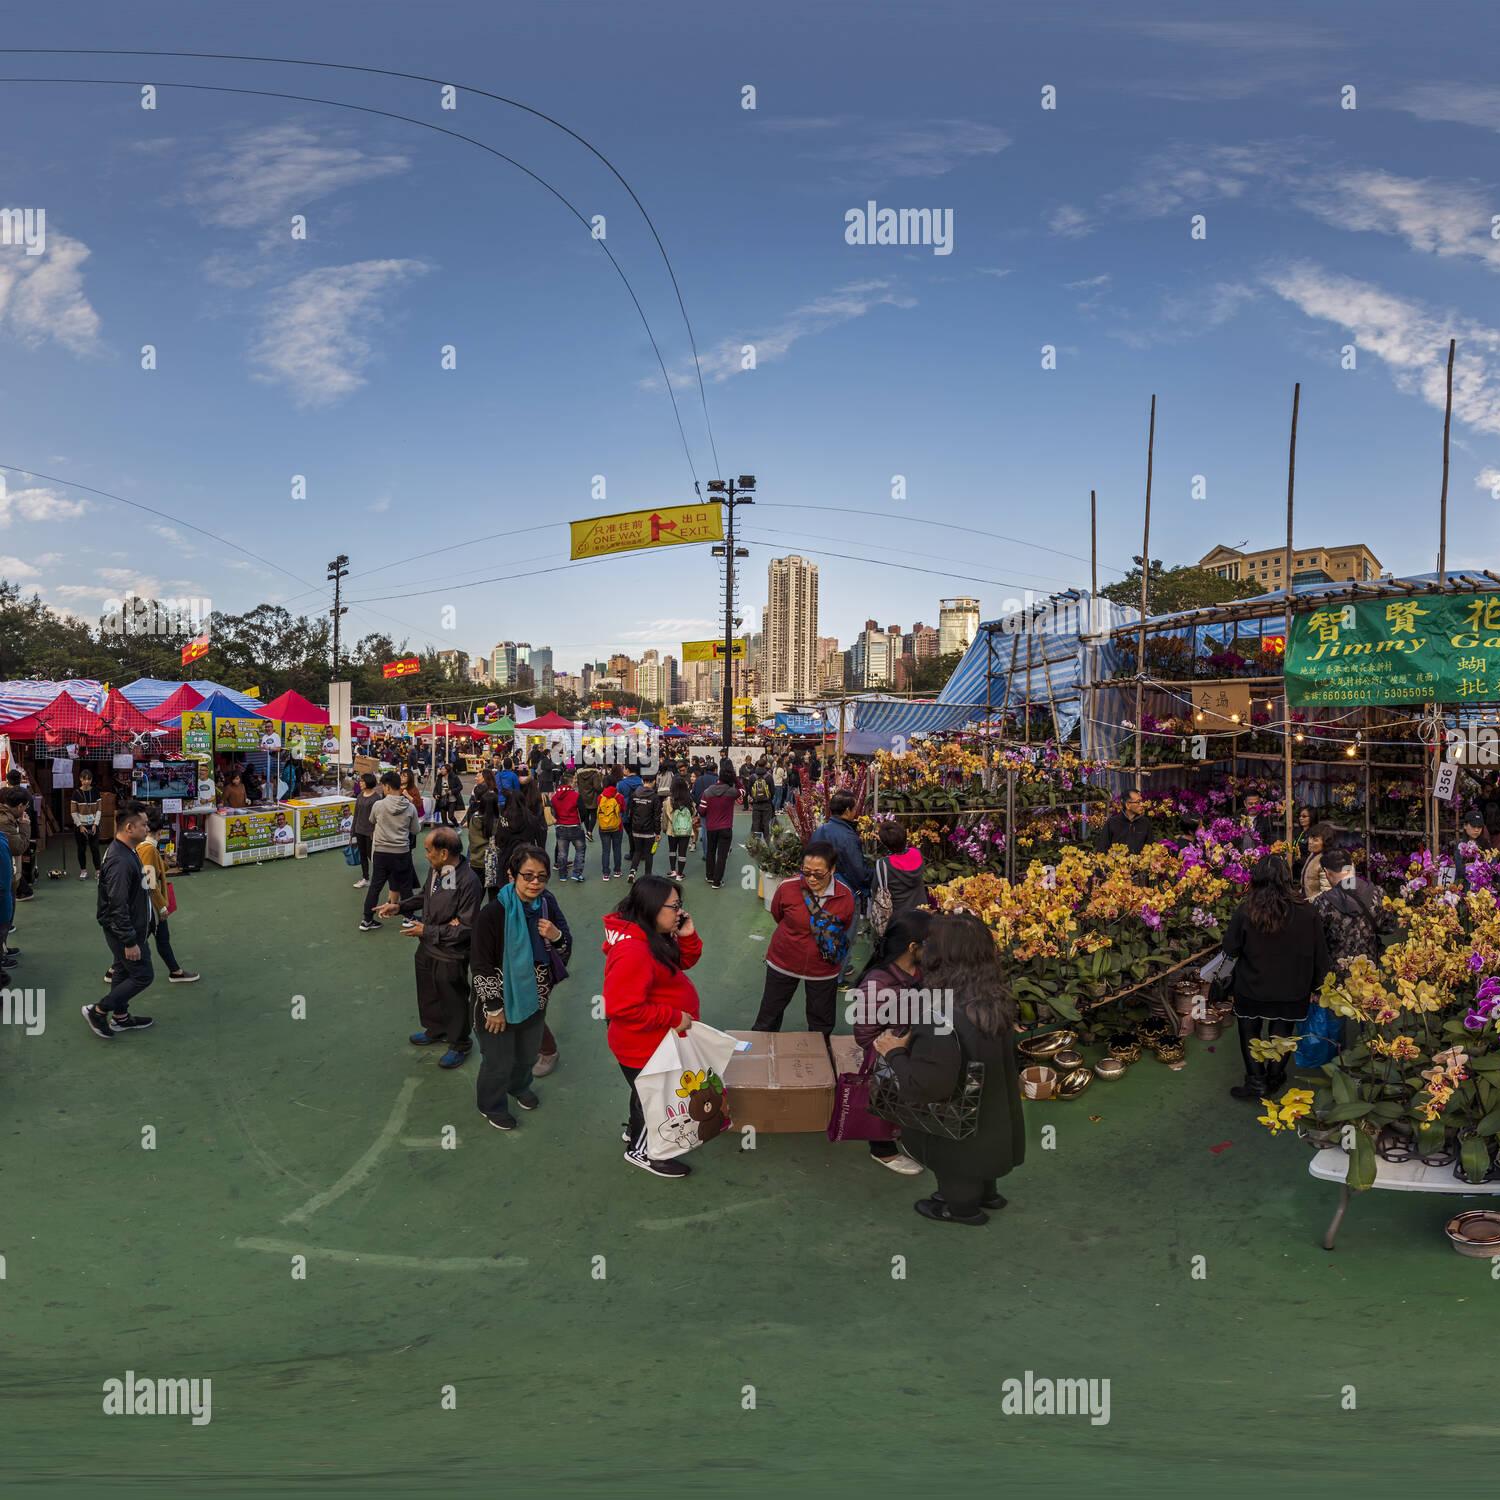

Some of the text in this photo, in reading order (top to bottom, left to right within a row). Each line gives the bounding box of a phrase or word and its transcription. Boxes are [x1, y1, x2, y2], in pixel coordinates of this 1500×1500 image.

[681, 512, 707, 524] 出口
[593, 519, 644, 536] 只准往前
[680, 525, 709, 537] EXIT
[593, 534, 616, 545] ONE
[619, 530, 643, 541] WAY
[1306, 637, 1427, 661] Jimmy
[1384, 686, 1435, 699] 53055055
[1438, 768, 1453, 794] 356
